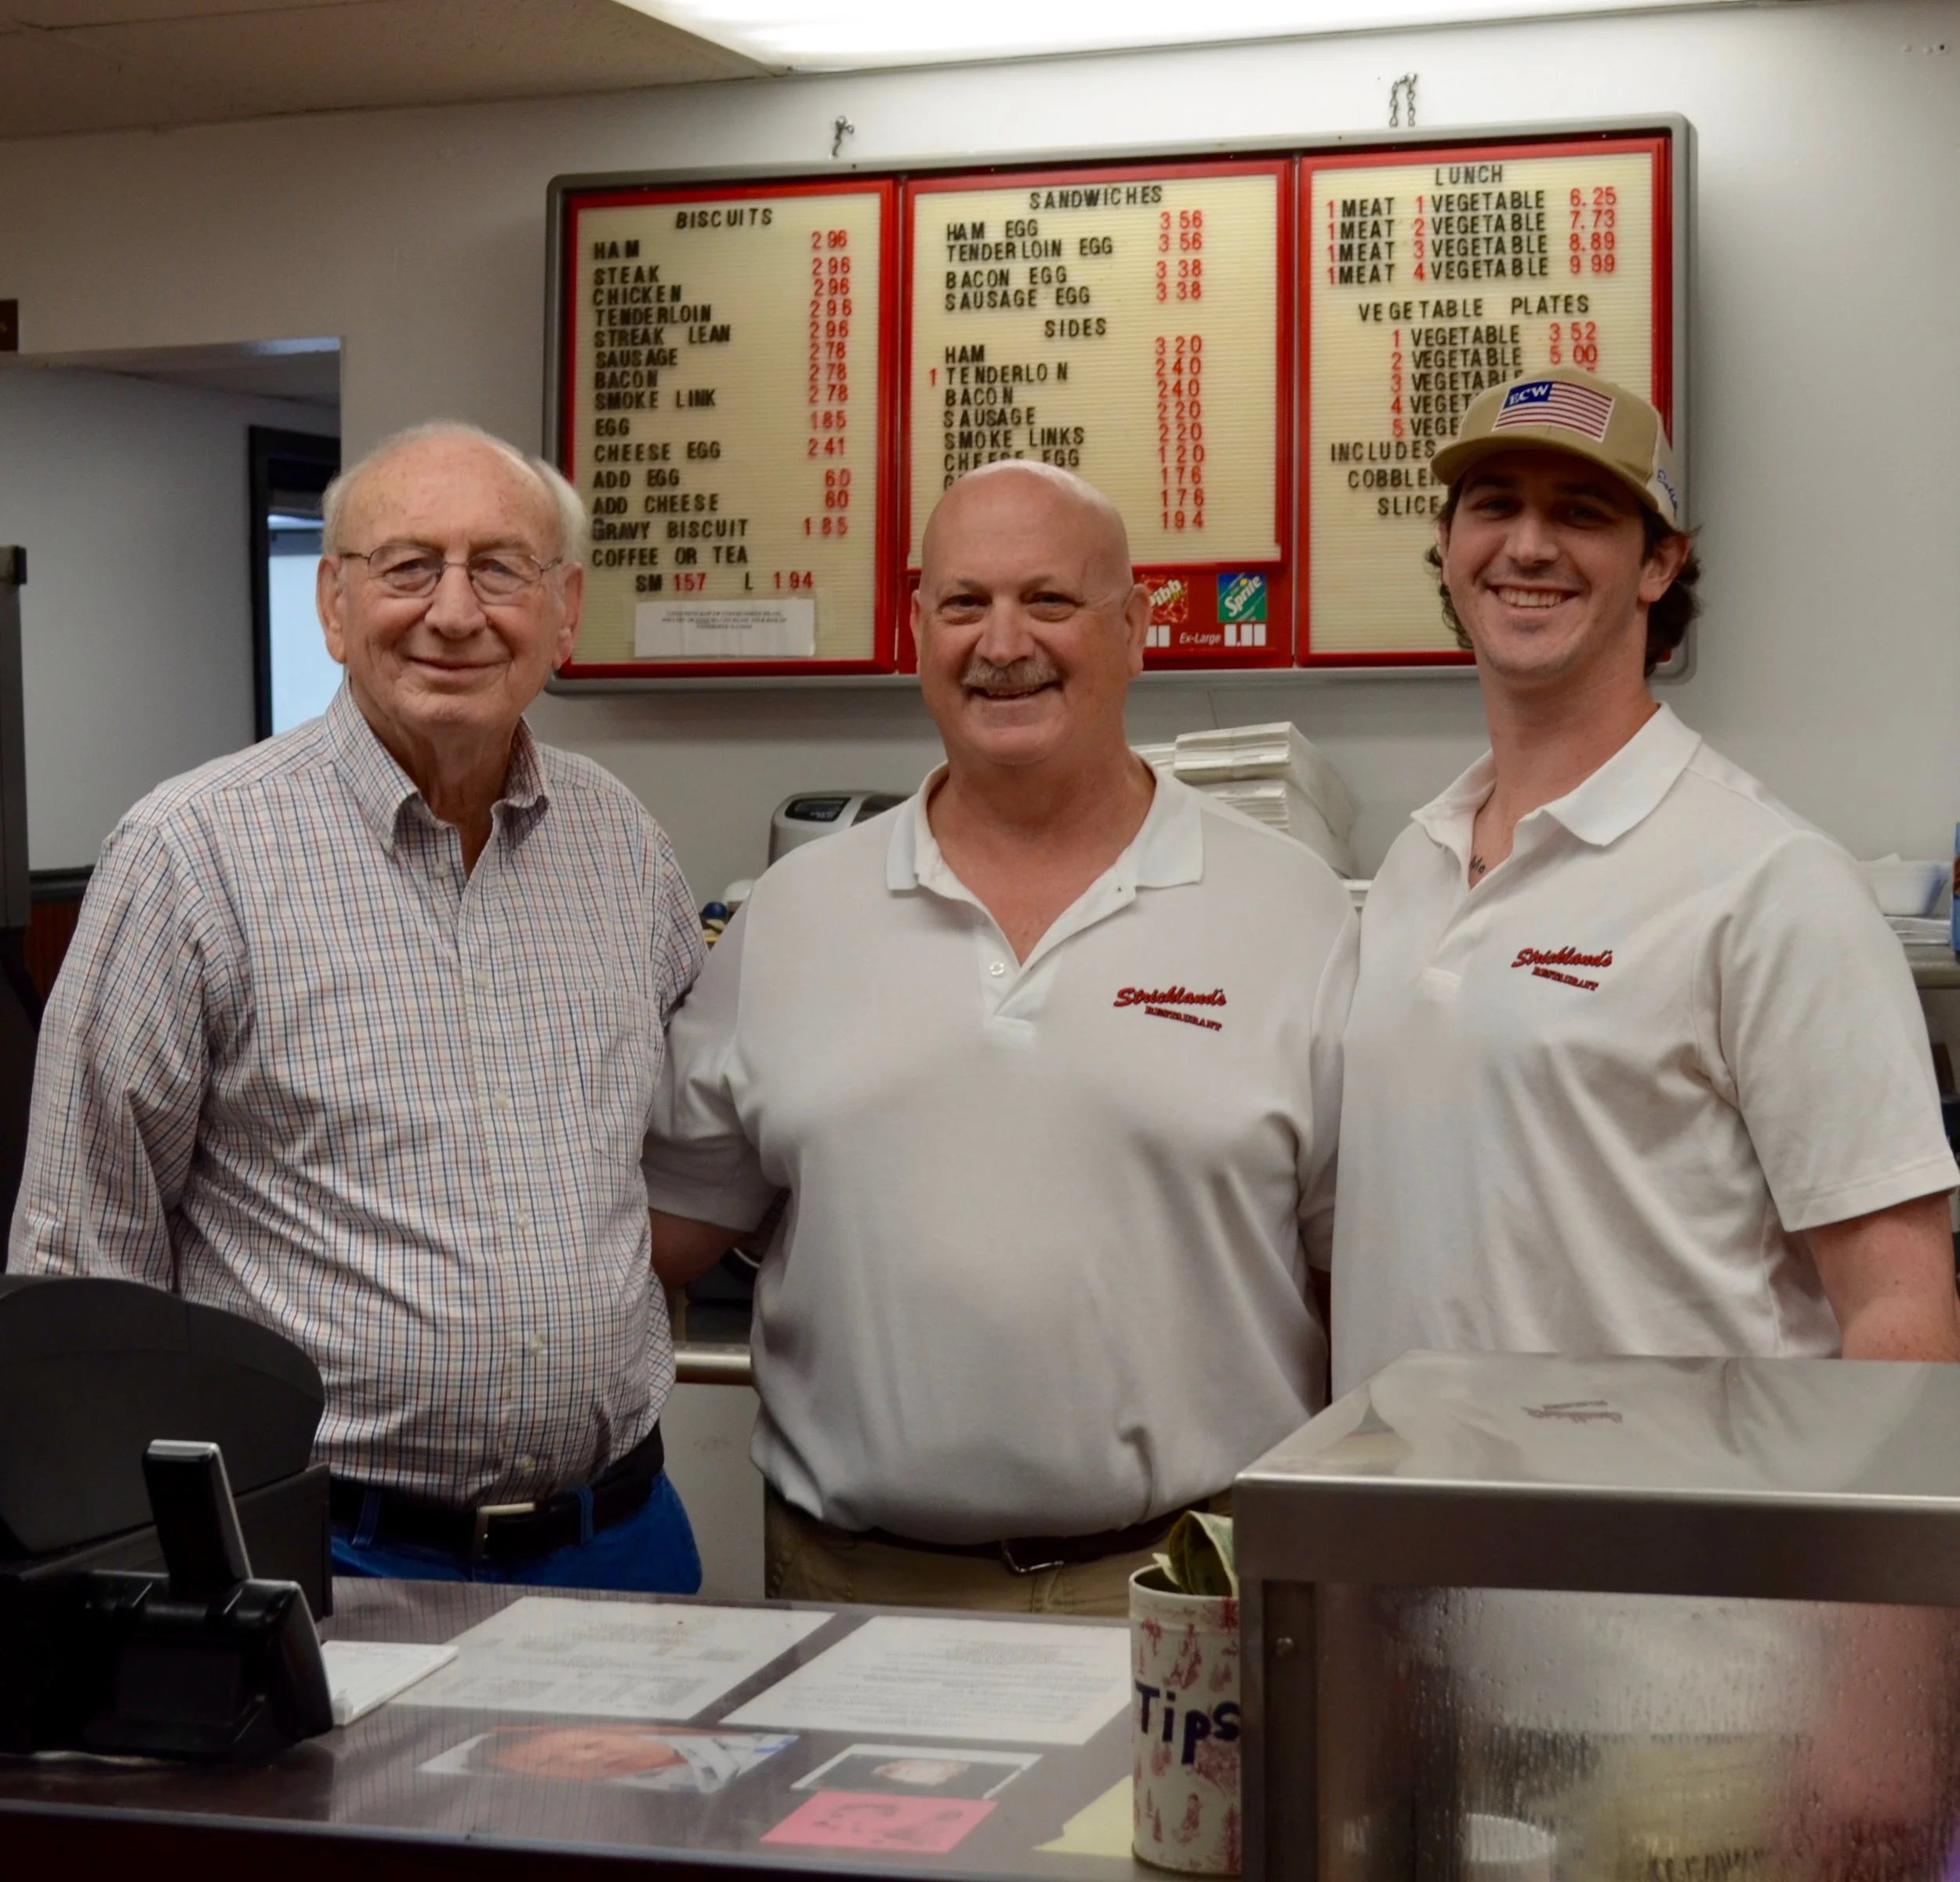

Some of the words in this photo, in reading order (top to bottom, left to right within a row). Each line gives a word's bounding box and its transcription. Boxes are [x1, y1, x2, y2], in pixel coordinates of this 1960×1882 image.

[1435, 165, 1503, 186] LUNCH
[1029, 185, 1163, 209] SANDWICHES
[1342, 197, 1396, 218] MEAT
[1414, 196, 1425, 213] 1
[1432, 190, 1548, 213] VEGETABLE
[676, 207, 774, 230] BISCUITS
[1340, 220, 1396, 241] MEAT
[1414, 218, 1425, 236] 2
[1432, 213, 1548, 235] VEGETABLE
[946, 221, 985, 241] HAM
[1005, 220, 1038, 237] EGG
[593, 240, 640, 260] HAM
[946, 239, 1062, 262] TENDERLOIN
[1080, 237, 1113, 256] EGG
[1339, 242, 1396, 263] MEAT
[1414, 241, 1425, 258] 3
[1432, 234, 1548, 257] VEGETABLE
[593, 266, 660, 285] STEAK
[946, 268, 1010, 290] BACON
[1029, 265, 1068, 285] EGG
[1339, 263, 1396, 285] MEAT
[1414, 263, 1425, 280] 4
[1432, 256, 1548, 280] VEGETABLE
[593, 285, 682, 306] CHICKEN
[946, 289, 1037, 312] SAUSAGE
[1055, 287, 1091, 306] EGG
[596, 304, 712, 327] TENDERLOIN
[1359, 298, 1483, 322] VEGETABLE
[1511, 294, 1589, 315] PLATES
[593, 328, 664, 347] STREAK
[688, 325, 730, 343] LEAN
[1044, 318, 1107, 337] SIDES
[1392, 330, 1400, 347] 1
[1411, 325, 1521, 347] VEGETABLE
[595, 348, 678, 369] SAUSAGE
[946, 344, 985, 363] HAM
[1391, 353, 1402, 370] 2
[1412, 347, 1523, 369] VEGETABLE
[594, 370, 658, 389] BACON
[928, 369, 937, 387] 1
[1391, 375, 1402, 392] 3
[594, 391, 658, 410] SMOKE
[676, 389, 716, 408] LINK
[946, 387, 1014, 407] BACON
[1391, 396, 1402, 414] 4
[1509, 384, 1549, 405] ECW
[595, 418, 630, 437] EGG
[944, 407, 1036, 427] SAUSAGE
[945, 430, 1012, 451] SMOKE
[1029, 427, 1085, 446] LINKS
[1392, 419, 1403, 438] 5
[594, 442, 671, 463] CHEESE
[687, 441, 720, 459] EGG
[1331, 440, 1436, 462] INCLUDES
[593, 470, 631, 489] ADD
[646, 468, 681, 486] EGG
[593, 496, 626, 514] ADD
[644, 494, 719, 513] CHEESE
[592, 518, 650, 541] GRAVY
[667, 518, 749, 540] BISCUIT
[592, 547, 659, 567] COFFEE
[675, 547, 697, 565] OR
[713, 546, 748, 565] TEA
[636, 574, 662, 593] SM
[673, 572, 706, 591] 157
[744, 572, 753, 590] L
[1224, 576, 1262, 617] Sprite
[1179, 633, 1221, 645] Ex-Large
[1113, 985, 1227, 1008] Strickland's
[1145, 1006, 1222, 1032] RESTAURANT
[1134, 1679, 1240, 1764] Tips
